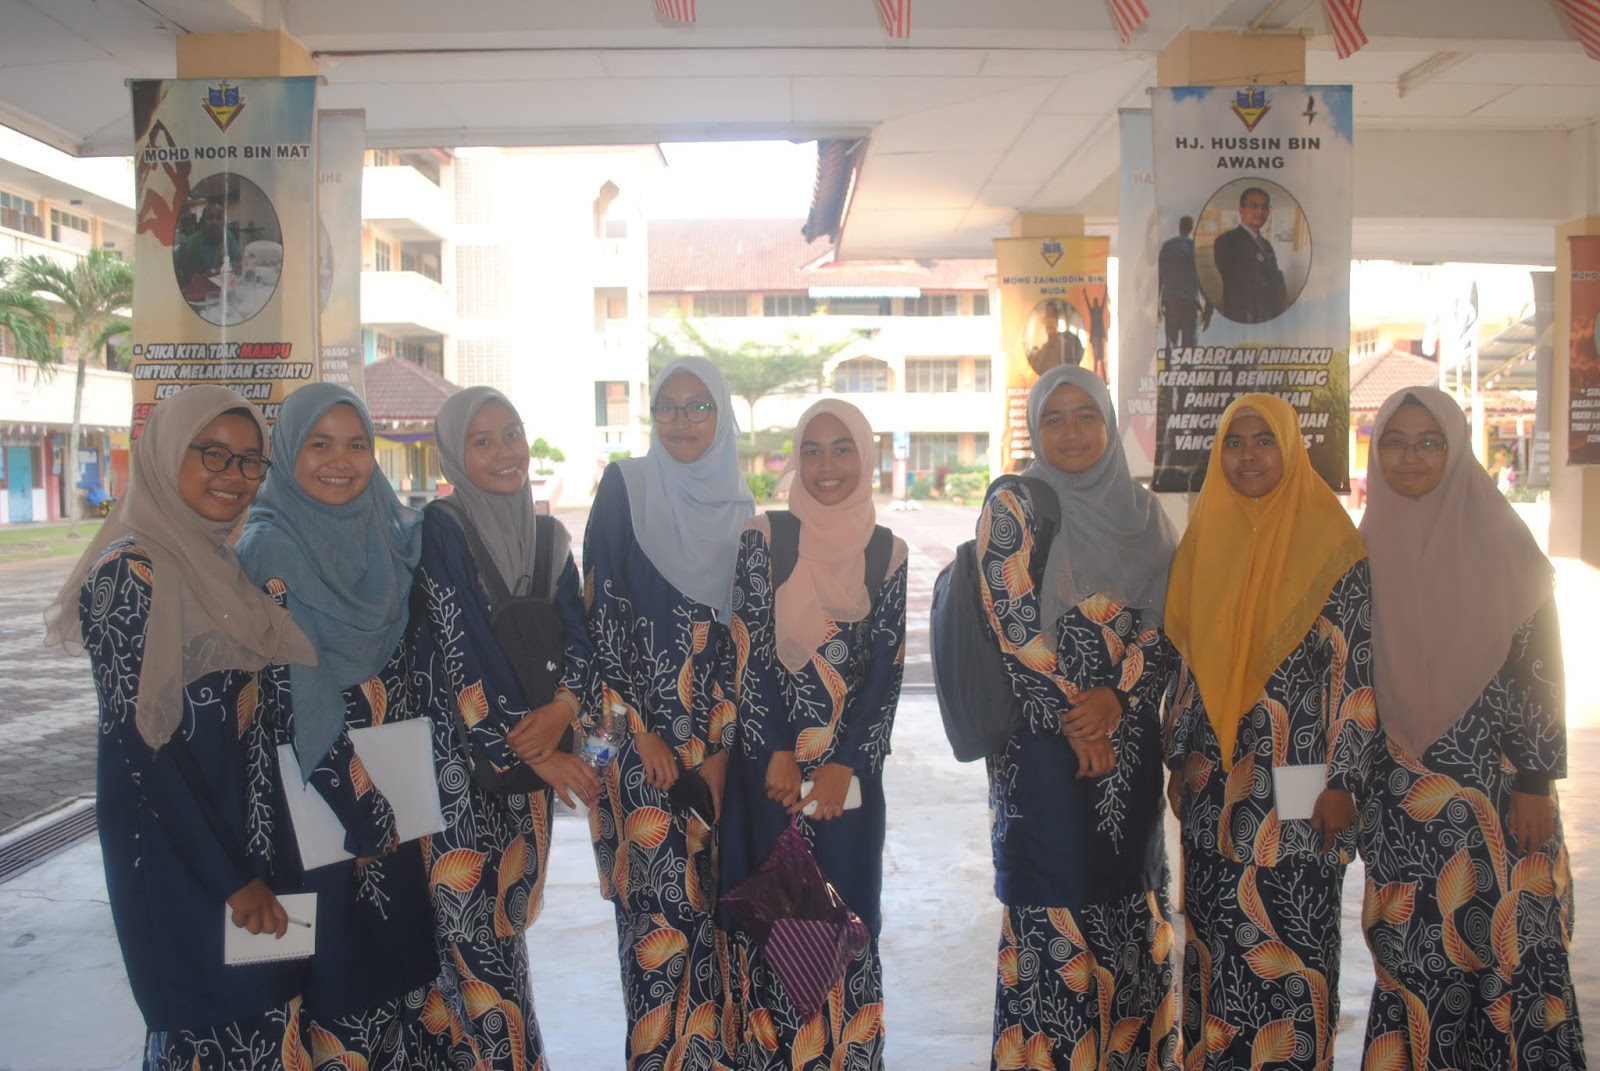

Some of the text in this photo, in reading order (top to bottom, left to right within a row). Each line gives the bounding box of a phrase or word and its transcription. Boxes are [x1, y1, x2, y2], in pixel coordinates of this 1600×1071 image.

[1175, 137, 1321, 150] HJ. HUSSIN BIN
[144, 145, 310, 162] MOHD NOOR BIN MAT
[1216, 156, 1285, 169] AWANG
[175, 343, 207, 360] KITA
[239, 342, 291, 359] MAMPU
[1170, 347, 1256, 364] SABARLAH
[1258, 348, 1332, 364] ANNAKKU
[135, 364, 178, 379] UNTUK
[178, 364, 253, 379] MELAKUKAN
[254, 363, 312, 379] SESUATU
[1157, 371, 1215, 386] KERANA
[1217, 371, 1233, 386] IA
[1236, 370, 1285, 386] BENIH
[1287, 370, 1328, 386] YANG
[1183, 392, 1230, 408] PAHIT
[1298, 412, 1329, 428] UAH
[1174, 435, 1216, 450] YANG
